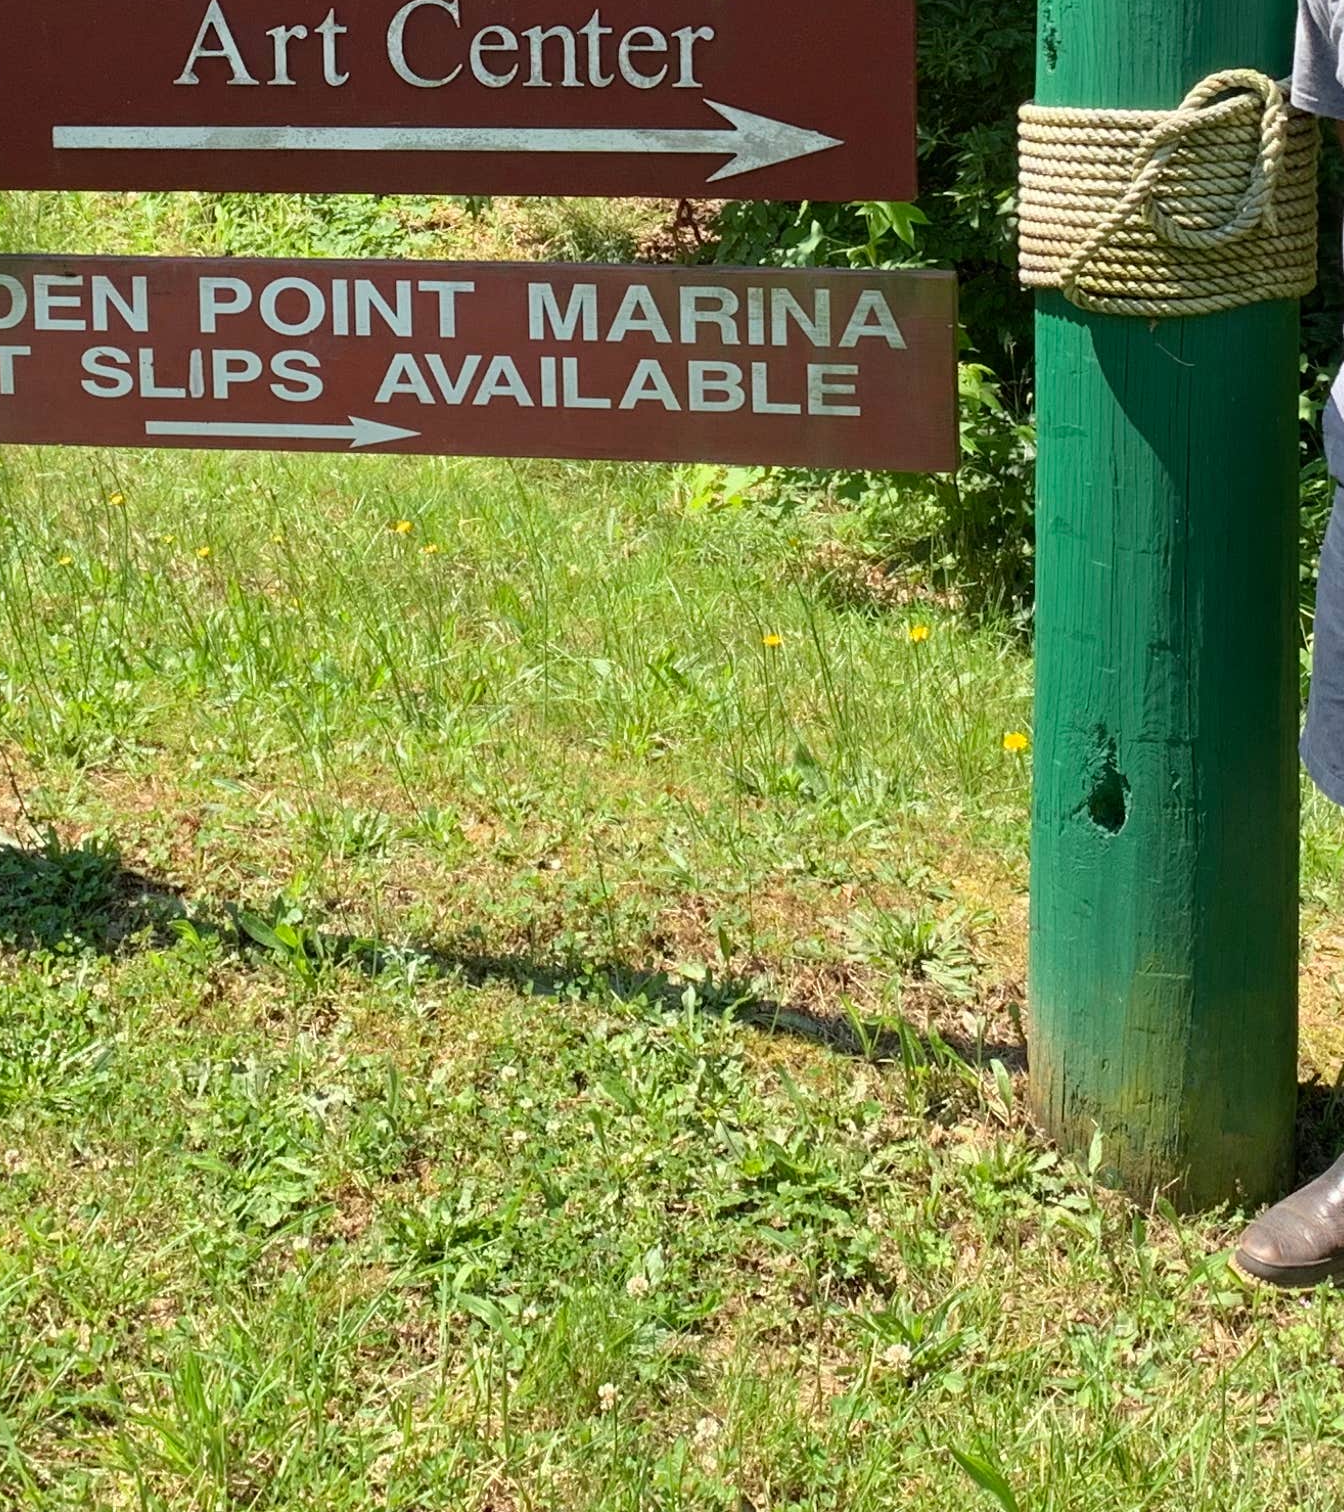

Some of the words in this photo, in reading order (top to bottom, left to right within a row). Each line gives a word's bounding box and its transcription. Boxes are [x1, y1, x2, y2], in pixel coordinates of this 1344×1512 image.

[199, 276, 476, 338] POINT
[527, 282, 907, 349] MARINA
[81, 346, 325, 402] SLIPS
[374, 353, 862, 417] AVAILABLE
